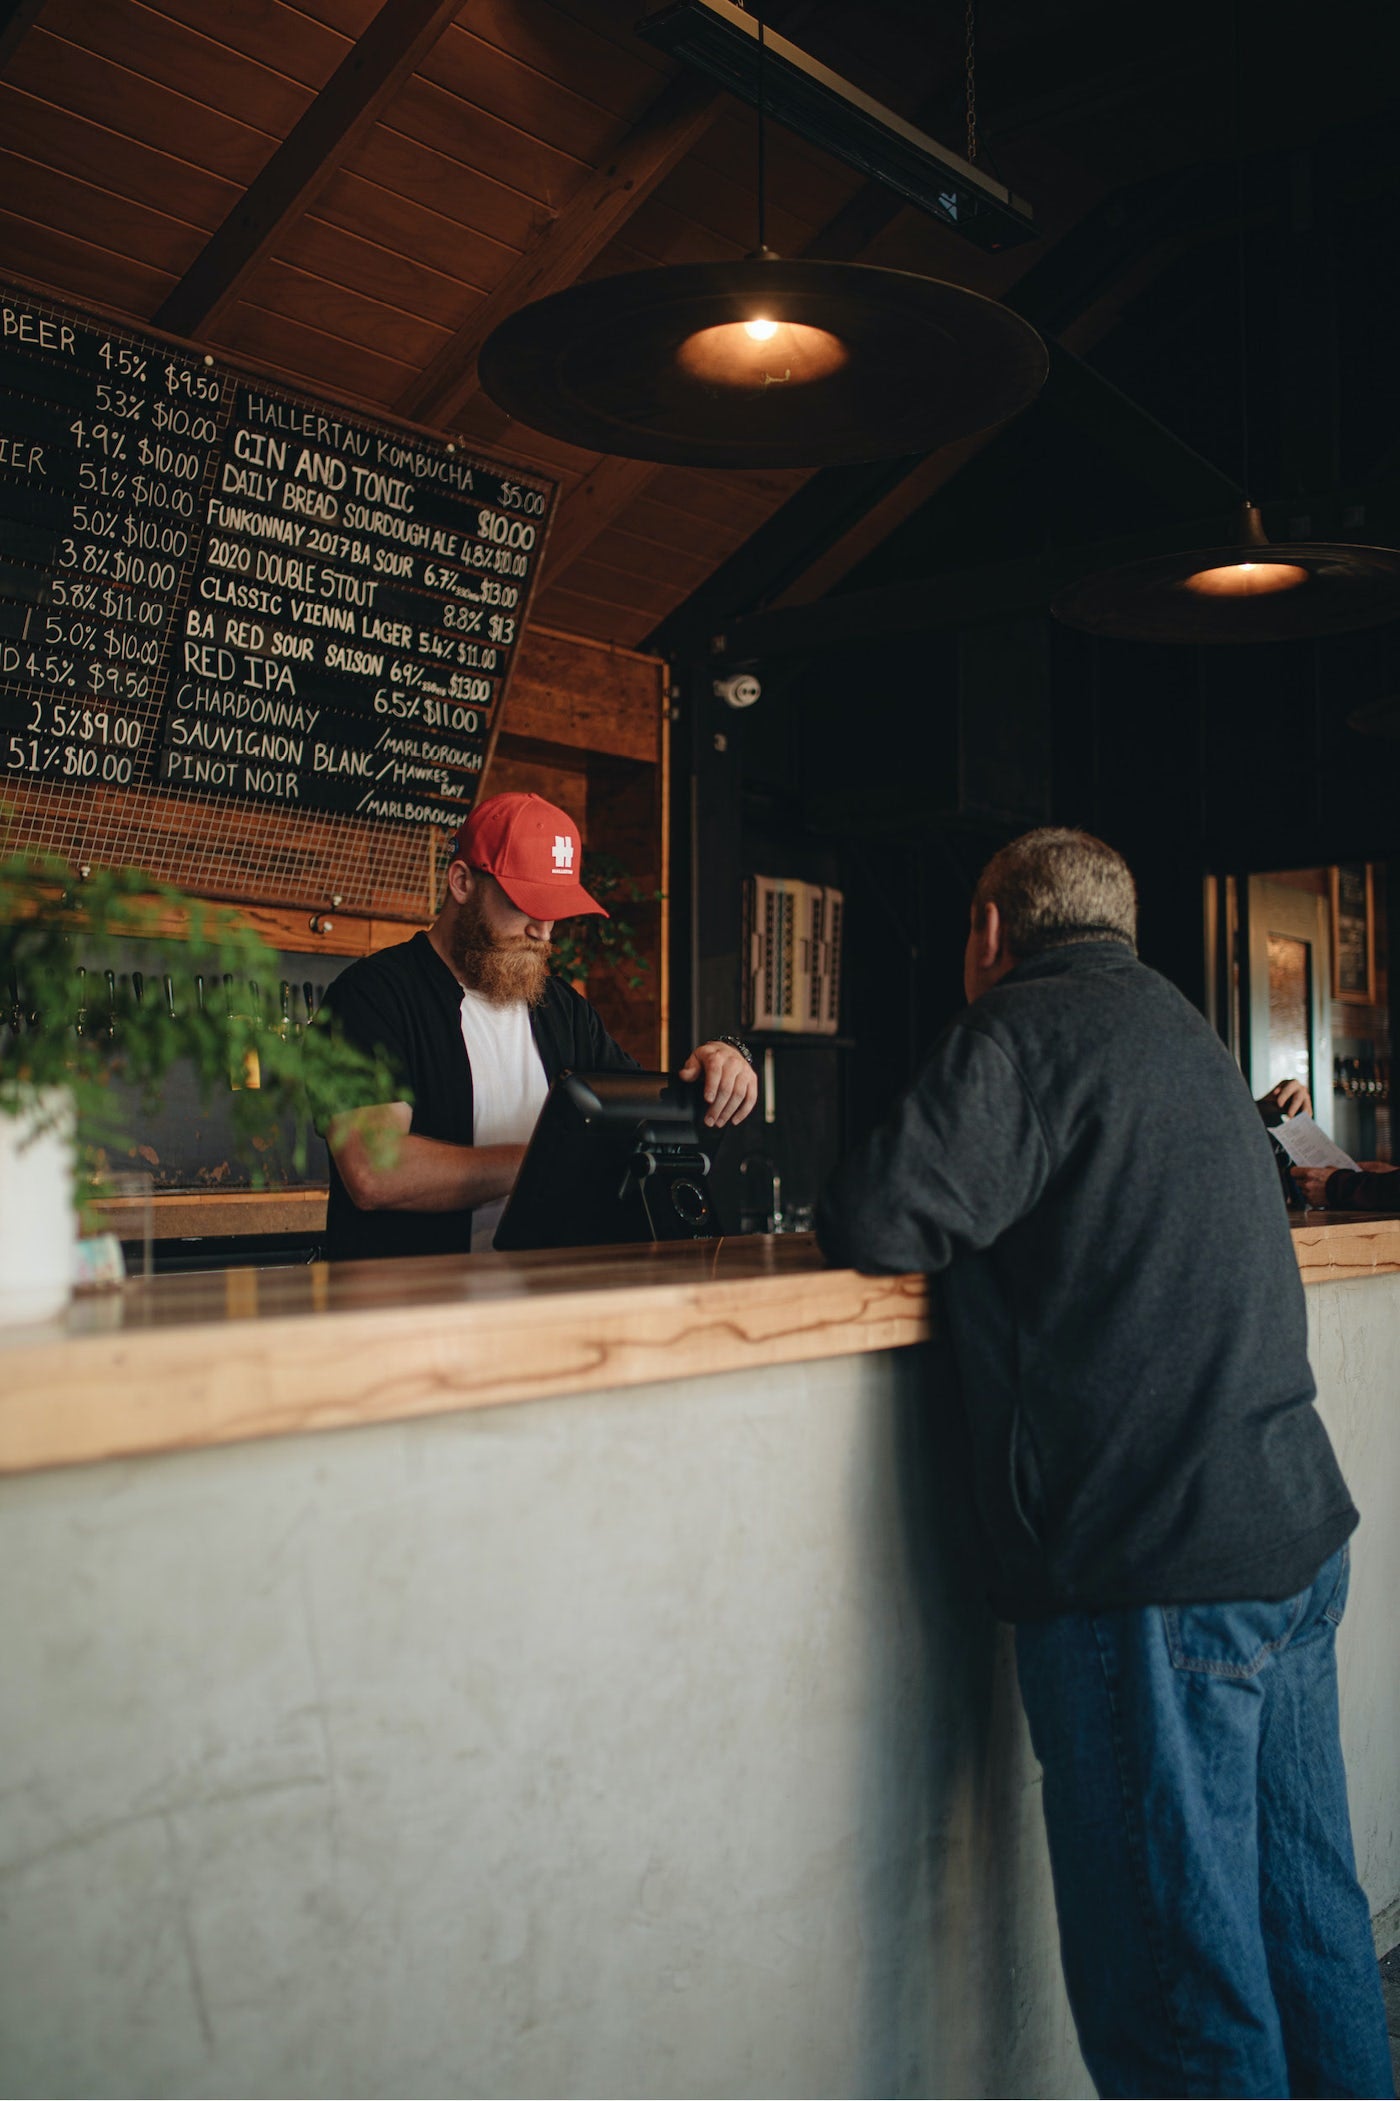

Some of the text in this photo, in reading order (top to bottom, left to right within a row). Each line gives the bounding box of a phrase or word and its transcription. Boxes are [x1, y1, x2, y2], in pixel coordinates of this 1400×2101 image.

[3, 308, 219, 402] BEER 4.5% $9.50
[96, 385, 217, 443] 5.3% $10.00
[70, 420, 199, 480] 4.9% $10.00
[248, 394, 546, 515] HALLERTAU KOMBUCHA $5.00
[79, 463, 127, 499] 5.1%
[131, 475, 193, 517] $10.00
[222, 463, 278, 502] DAILY
[282, 482, 338, 520] BREAD
[343, 502, 431, 549] SOURDOUGH
[430, 529, 459, 557] ALE
[234, 429, 536, 550] GIN AND TONIC $10.00
[73, 506, 187, 557] 5.0% $10.00
[207, 498, 307, 546] FUNKONNAY
[306, 527, 350, 558] 2017
[350, 540, 371, 566] BA
[373, 547, 415, 578] SOUR
[423, 564, 459, 592] 6.7%
[480, 576, 520, 609] $13.00
[59, 538, 175, 591] 3.8% $10.00
[208, 538, 516, 645] 2020 DOUBLE STOUT 8.8% $13
[52, 580, 164, 626] 5.8% $11.00
[200, 576, 498, 670] CLASSIC VIENNA LAGER 5.4% $11.00
[45, 616, 159, 665] 5.0% $10.00
[224, 618, 265, 651] RED
[270, 631, 314, 662] SOUR
[324, 643, 384, 677] SAISON
[390, 659, 426, 688] 6.9%
[25, 652, 76, 687] 4.5%
[87, 662, 149, 698] $9.50
[184, 641, 479, 733] RED IPA 6.5% $11.00
[27, 701, 142, 749] 2.5% $9.00
[176, 683, 320, 734] CHARDONNAY
[7, 737, 132, 784] 5.1% $10.00
[167, 752, 300, 799] PINOT NOIR
[171, 718, 304, 766] SAUVIGNON
[313, 743, 375, 777] BLANC
[440, 782, 466, 799] BAY
